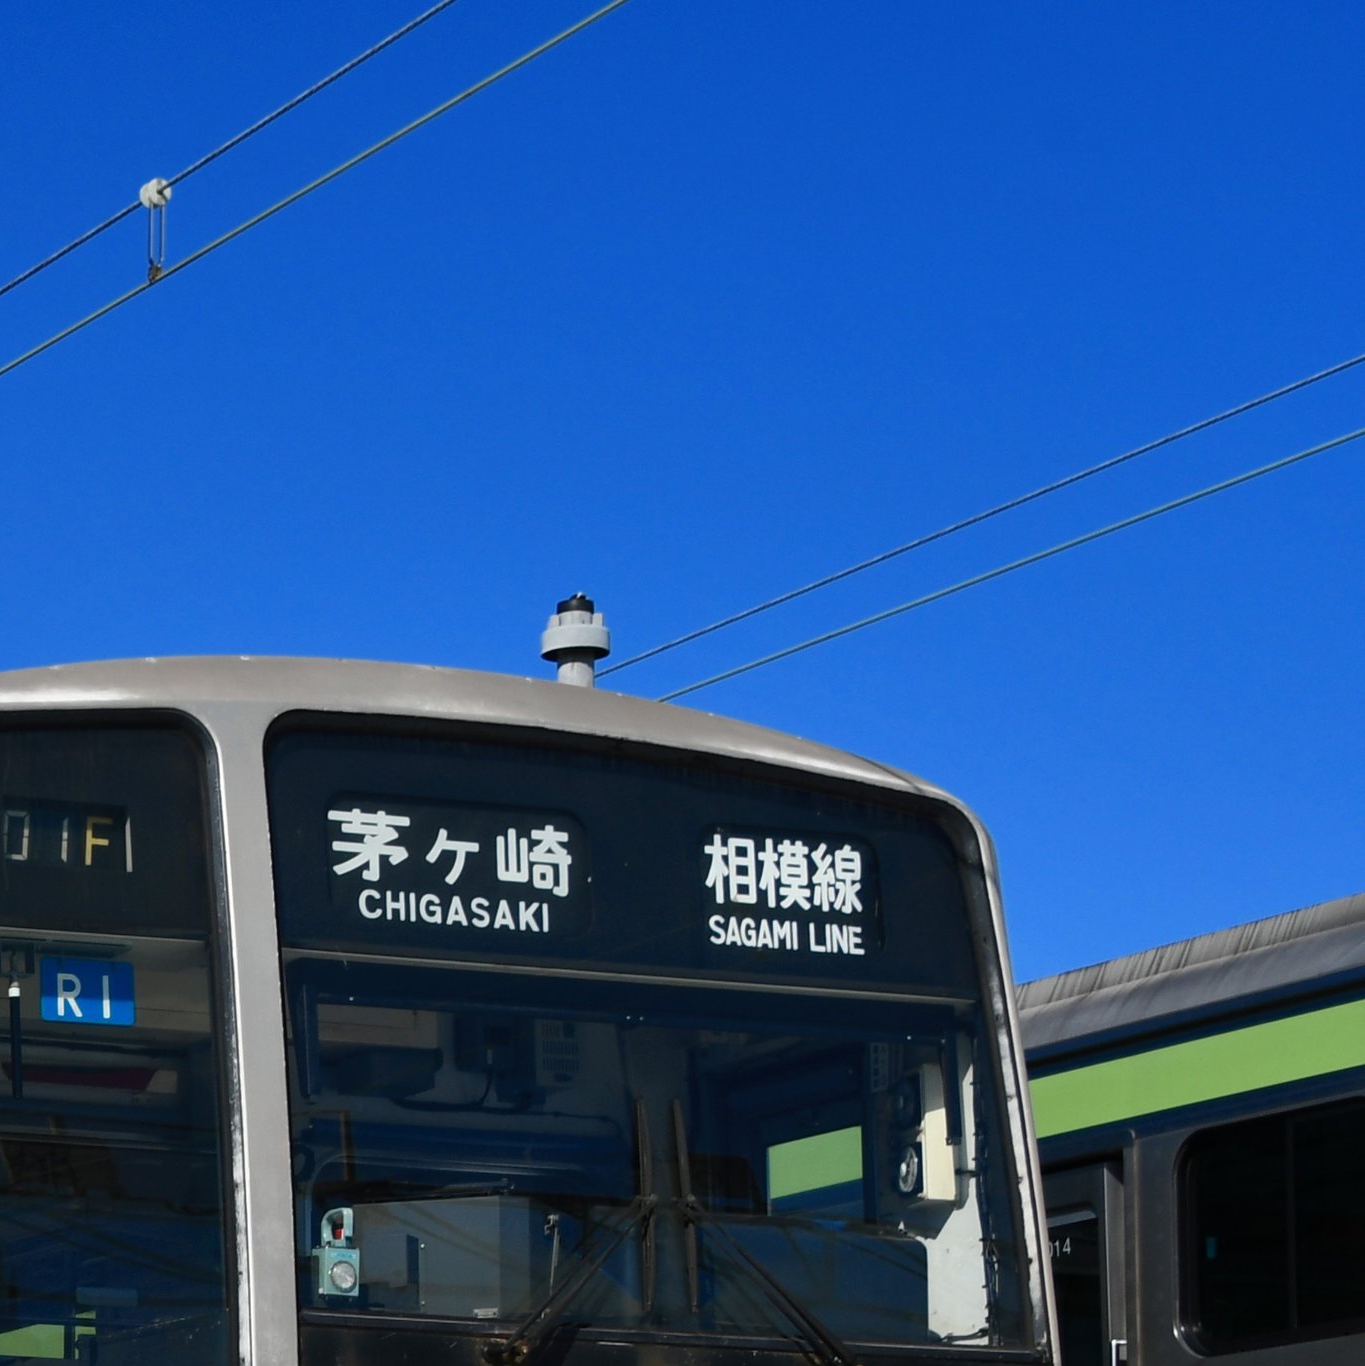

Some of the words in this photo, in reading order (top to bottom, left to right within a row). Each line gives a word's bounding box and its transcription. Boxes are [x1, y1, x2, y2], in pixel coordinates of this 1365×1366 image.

[704, 834, 862, 914] 相模線
[358, 889, 549, 932] CHIGASAKI
[709, 916, 799, 950] SAGAMI
[809, 922, 865, 956] LINE
